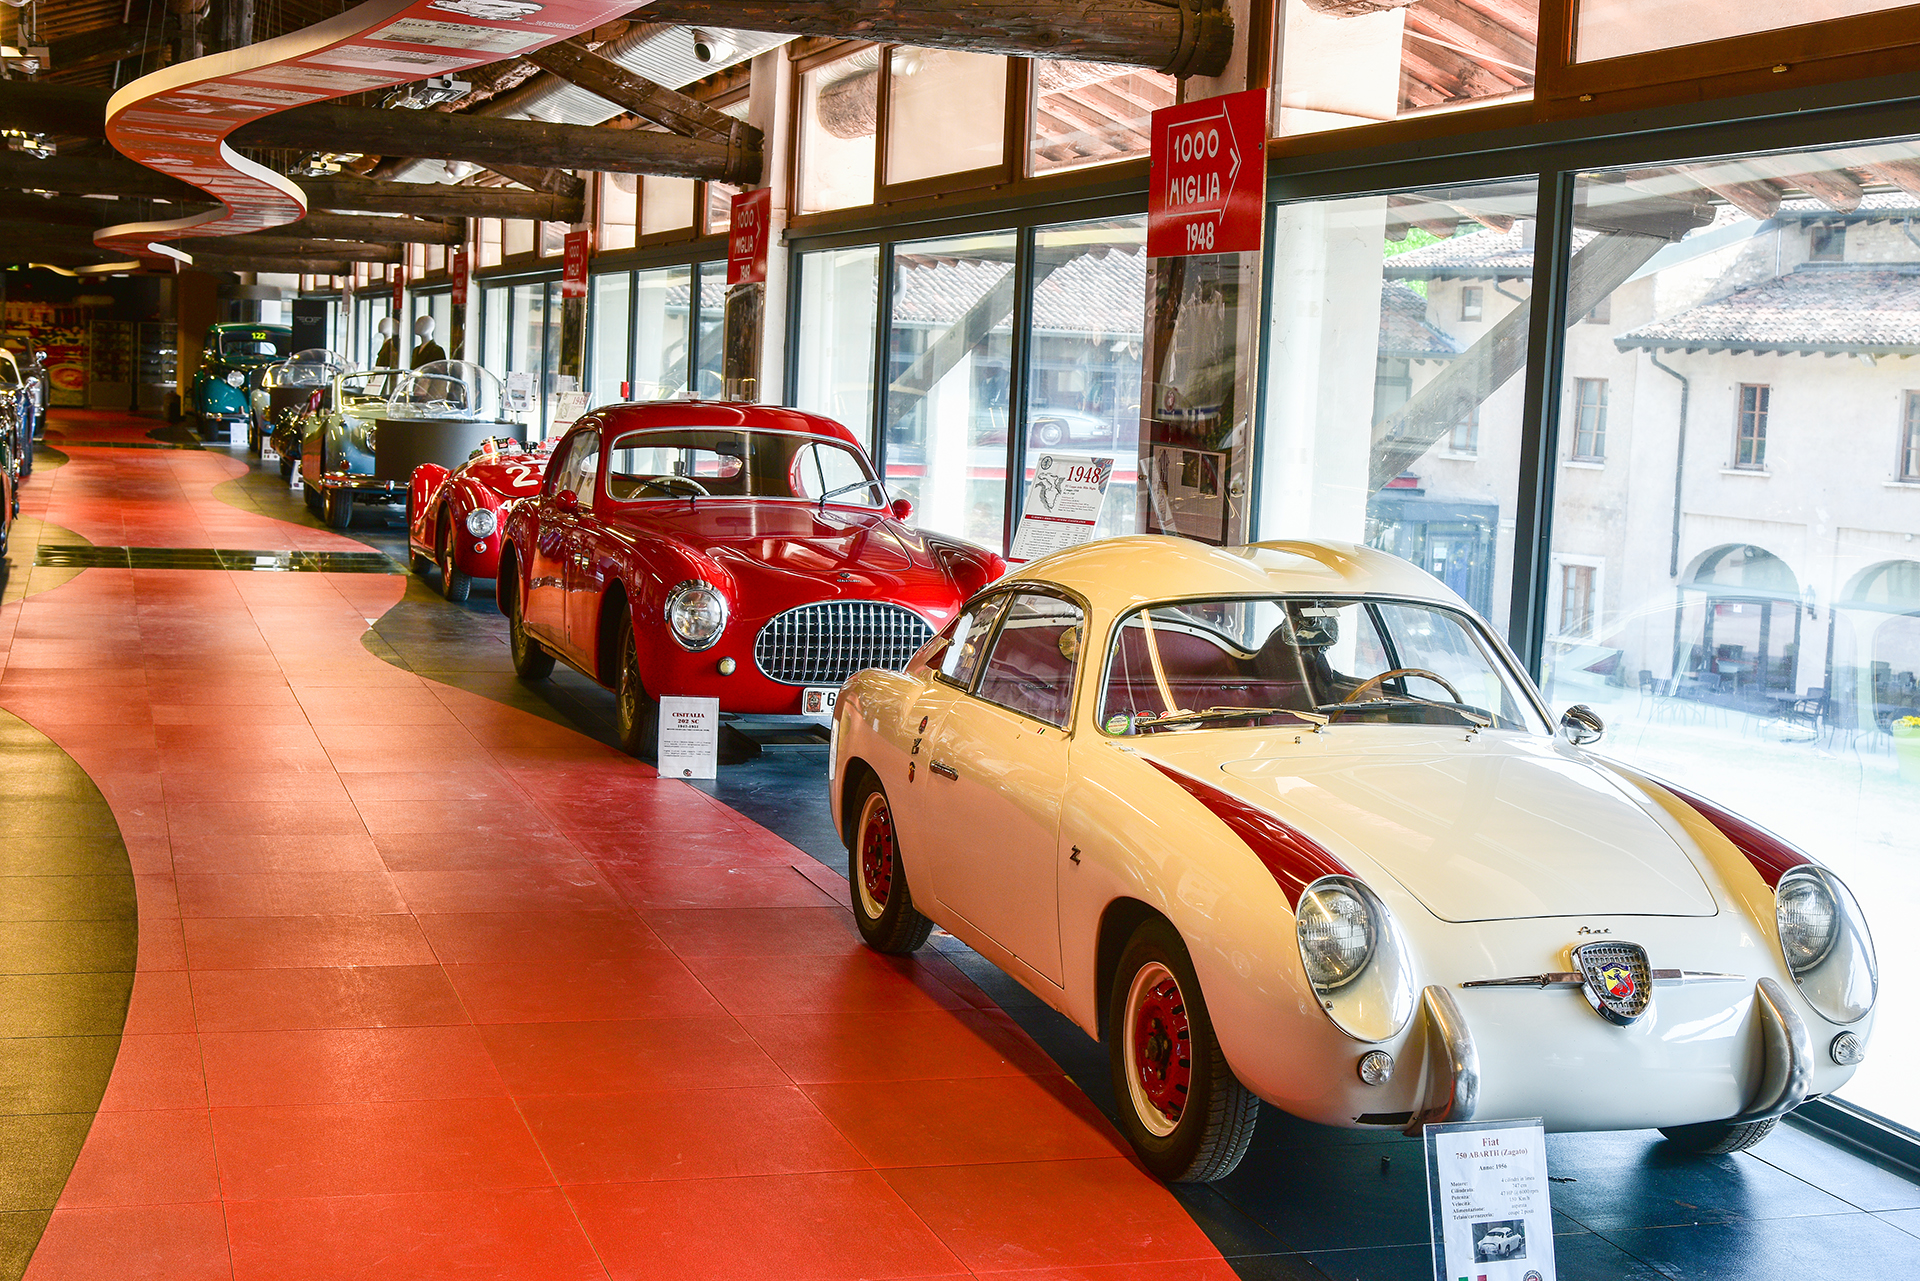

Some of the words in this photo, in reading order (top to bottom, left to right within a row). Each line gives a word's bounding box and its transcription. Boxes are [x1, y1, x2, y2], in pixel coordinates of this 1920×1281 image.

[1174, 128, 1220, 164] 1000
[1169, 172, 1221, 206] MIGLIA
[737, 209, 755, 229] 1000
[734, 235, 754, 254] MIGLIA
[1186, 221, 1215, 251] 1948
[251, 332, 266, 340] 122
[1067, 465, 1102, 484] 1948
[1482, 1138, 1500, 1147] Fiat
[1455, 1152, 1468, 1160] 750
[1468, 1150, 1500, 1159] ABARTH
[1501, 1148, 1528, 1158] (Zagato)
